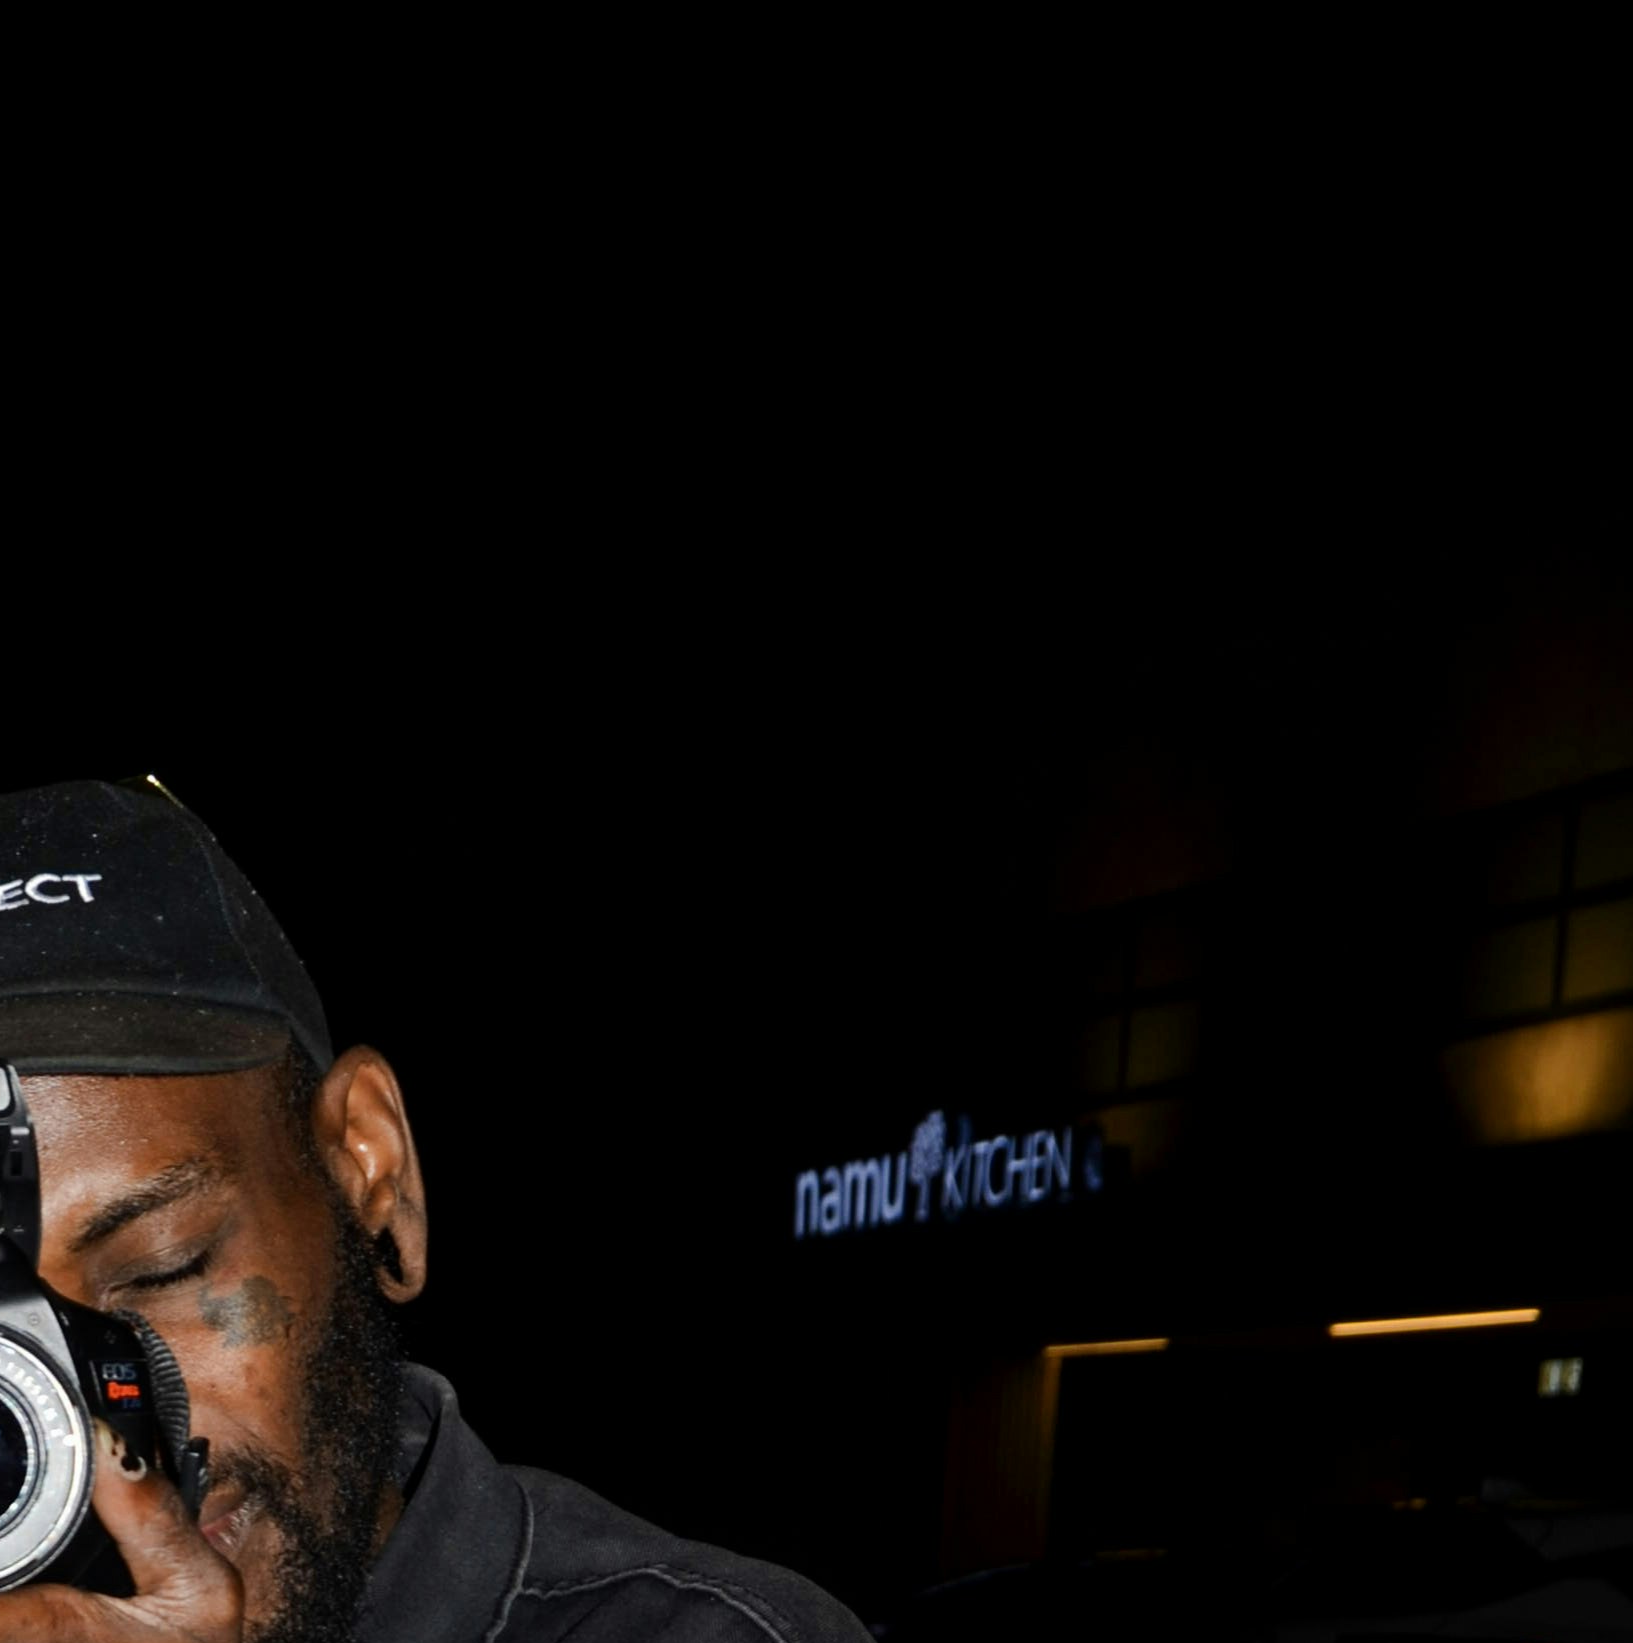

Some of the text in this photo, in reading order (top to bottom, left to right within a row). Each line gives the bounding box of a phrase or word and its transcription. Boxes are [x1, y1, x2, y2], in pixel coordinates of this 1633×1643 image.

[794, 1125, 1073, 1239] namu KITCHEN
[102, 1363, 137, 1380] EOS
